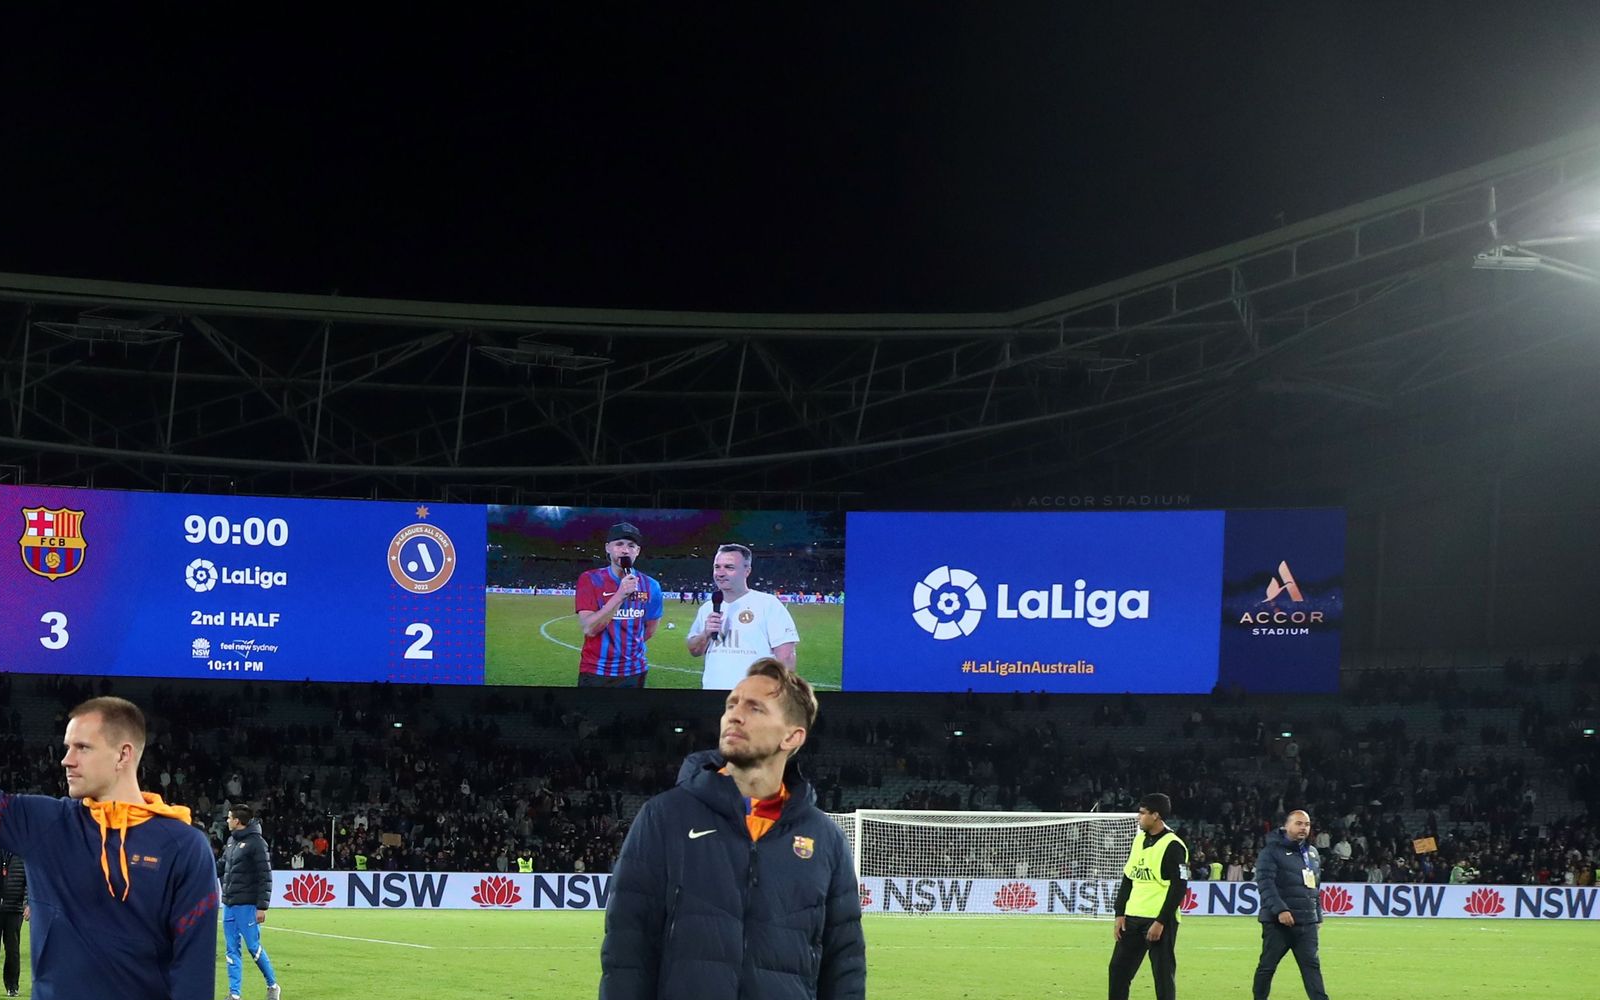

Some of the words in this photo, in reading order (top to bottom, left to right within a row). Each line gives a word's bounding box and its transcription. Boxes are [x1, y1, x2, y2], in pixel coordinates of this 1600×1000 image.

[184, 514, 289, 547] 90:00
[424, 527, 435, 536] ALL
[221, 566, 287, 589] LaLiga
[996, 578, 1150, 628] LaLiga
[1239, 610, 1324, 624] ACCOR
[39, 611, 70, 650] 3
[190, 610, 225, 626] 2nd
[230, 612, 280, 628] HALF
[1252, 627, 1310, 636] STADIUM
[220, 642, 235, 650] feel
[252, 643, 279, 653] sydney
[404, 622, 434, 660] 2
[207, 660, 240, 671] 10:11
[244, 661, 264, 672] PM
[961, 660, 1095, 676] #LaLigaInAustralia
[347, 873, 449, 908] NSW
[883, 879, 973, 912] NSW
[1208, 883, 1258, 915] NS
[1363, 884, 1446, 916] NSW
[1514, 887, 1599, 918] NSW
